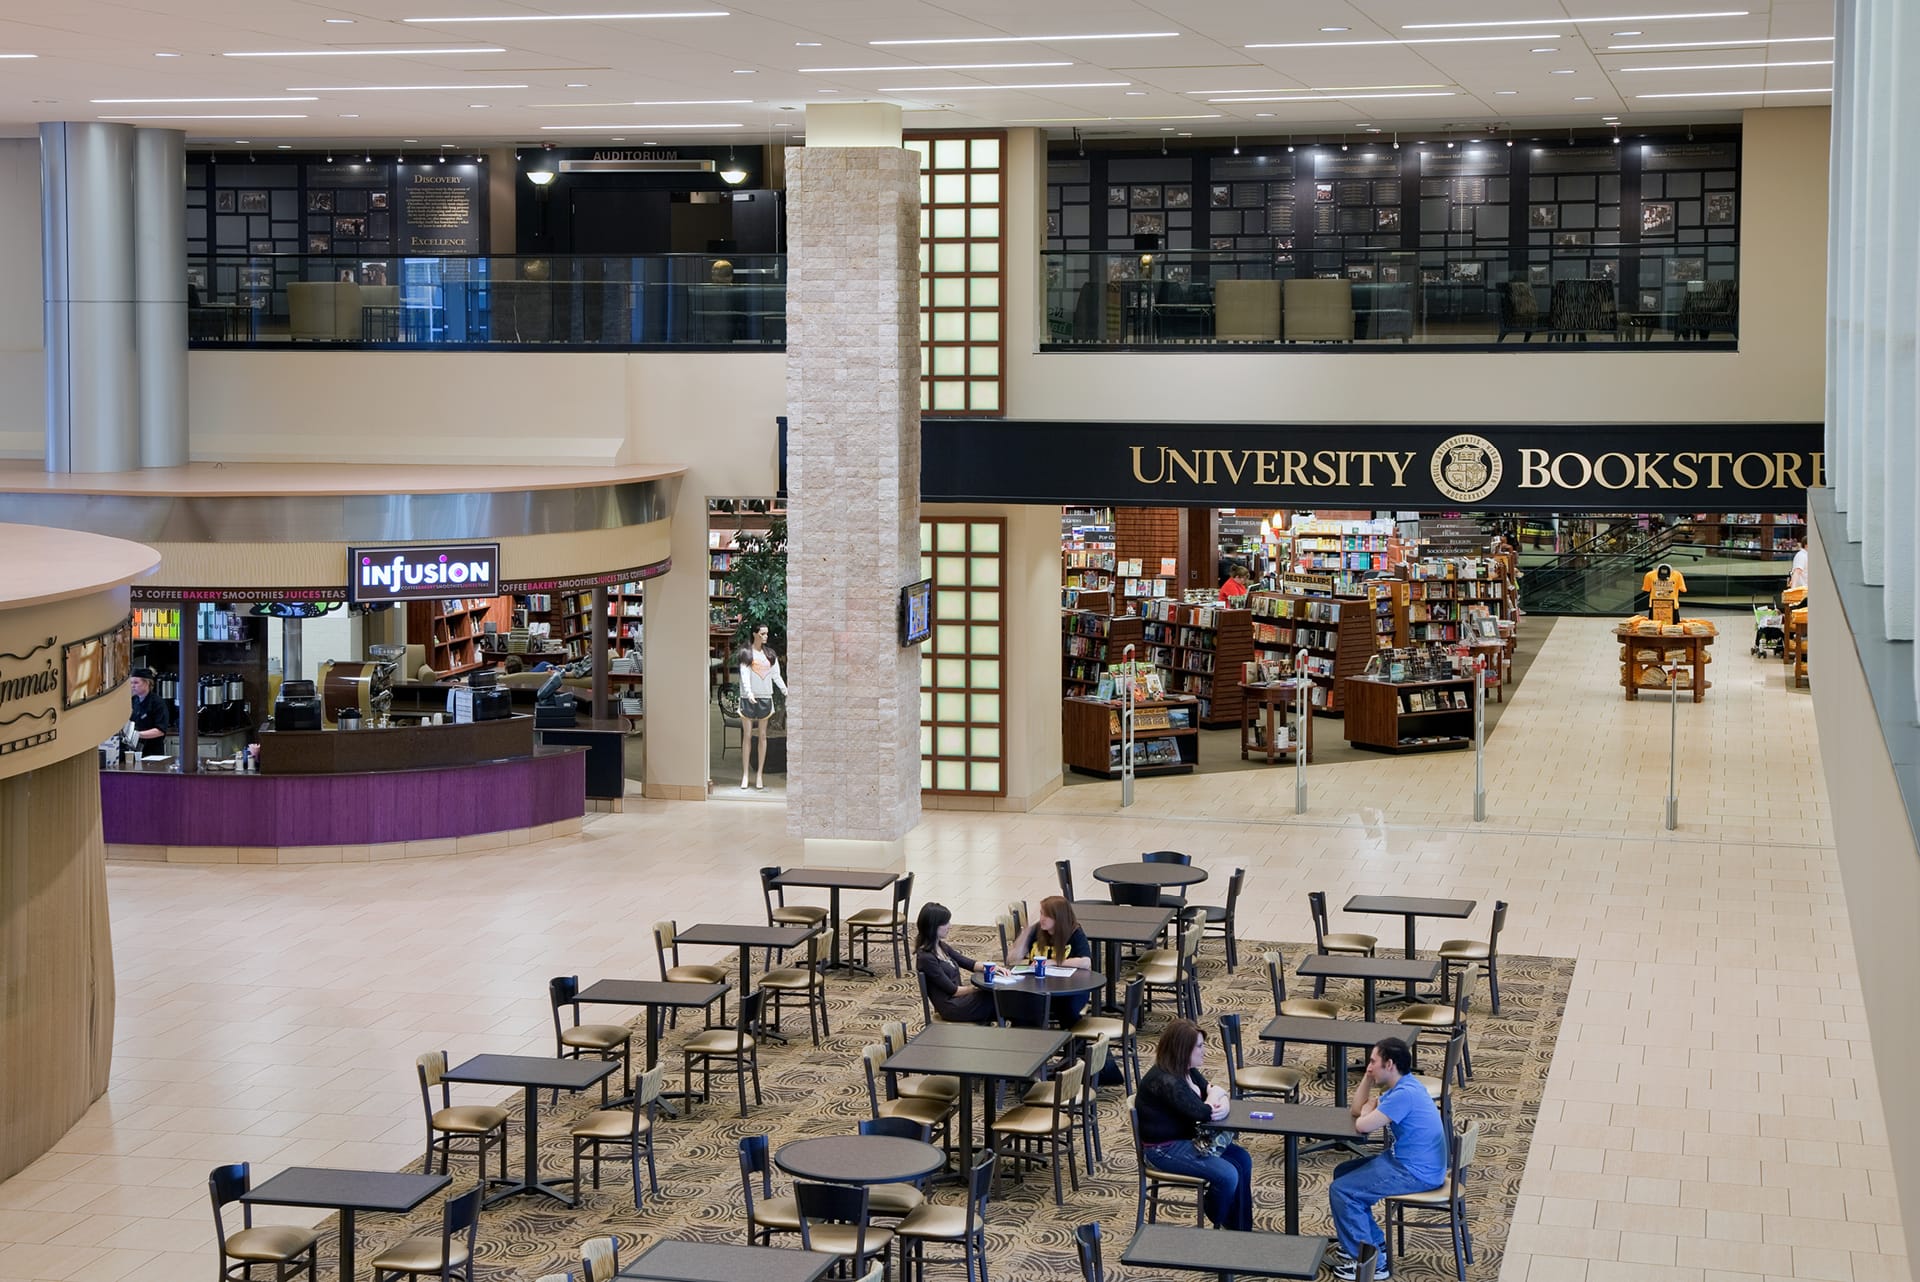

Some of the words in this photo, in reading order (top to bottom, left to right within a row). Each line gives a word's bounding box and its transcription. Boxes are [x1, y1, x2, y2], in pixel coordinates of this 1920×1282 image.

[593, 151, 678, 161] AUDITORIUM
[414, 174, 462, 184] DISCOVERY
[411, 236, 466, 246] EXCELLENCE
[1129, 446, 1416, 487] UNIVERSITY
[1285, 574, 1331, 585] BESTSELLERS
[0, 658, 58, 706] mma's
[0, 732, 56, 754] RAPS
